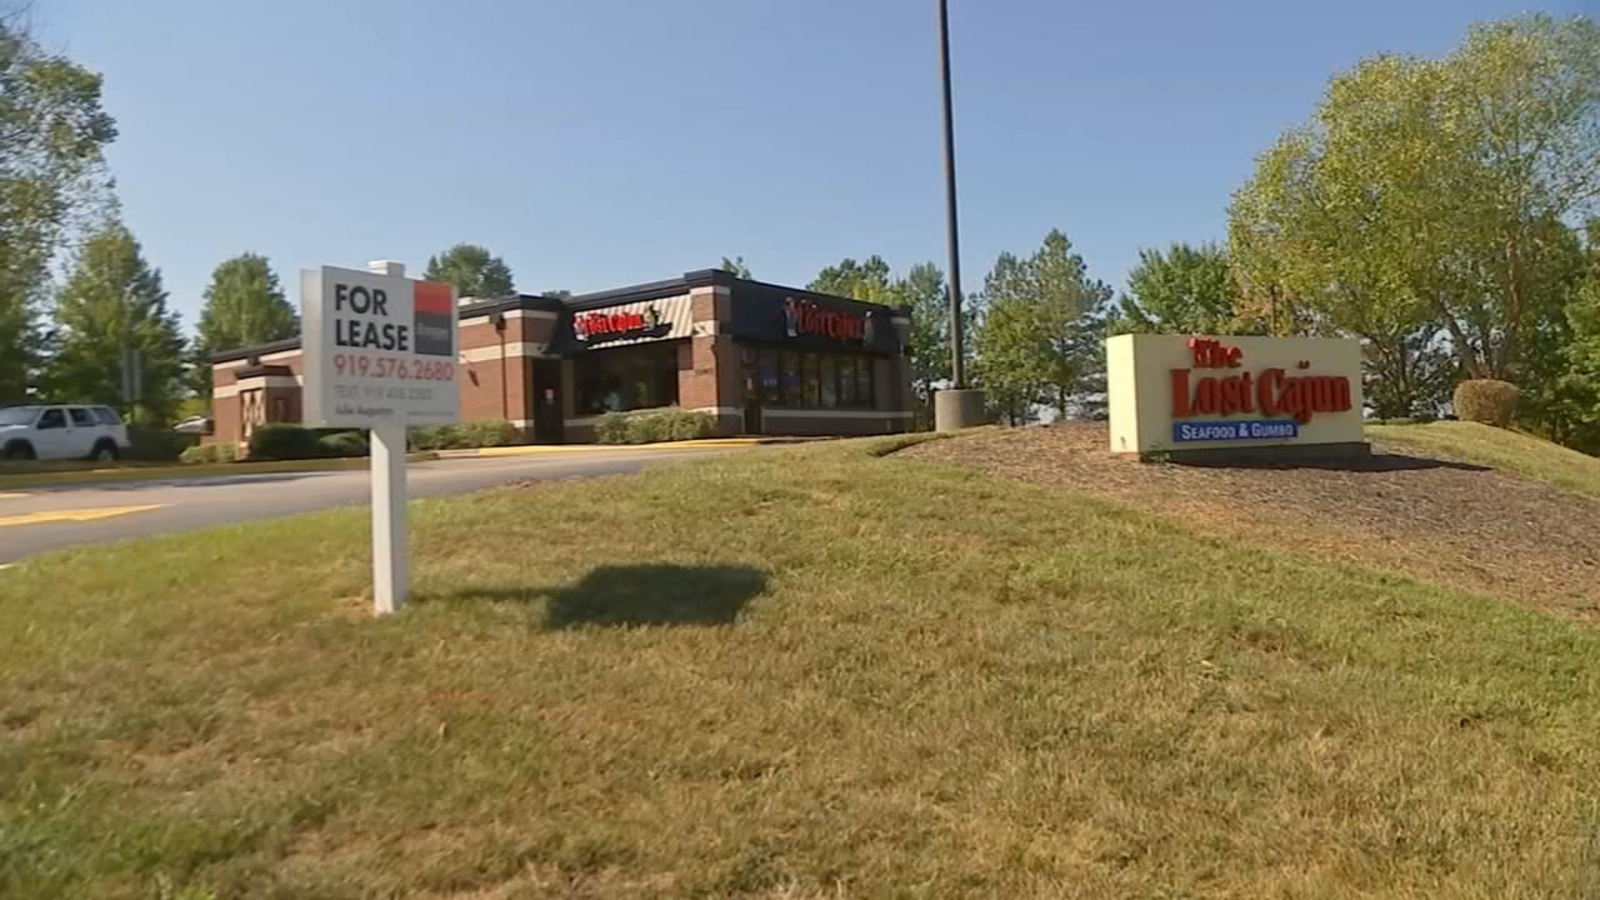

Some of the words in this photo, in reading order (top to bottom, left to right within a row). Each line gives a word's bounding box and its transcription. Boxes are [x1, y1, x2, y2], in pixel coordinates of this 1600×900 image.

[335, 284, 388, 316] FOR
[335, 318, 409, 351] LEASE
[334, 354, 454, 381] 919.576.2680
[1188, 337, 1242, 369] The
[1170, 368, 1256, 418] Lost
[1257, 360, 1352, 424] Cajun
[1238, 422, 1249, 437] &
